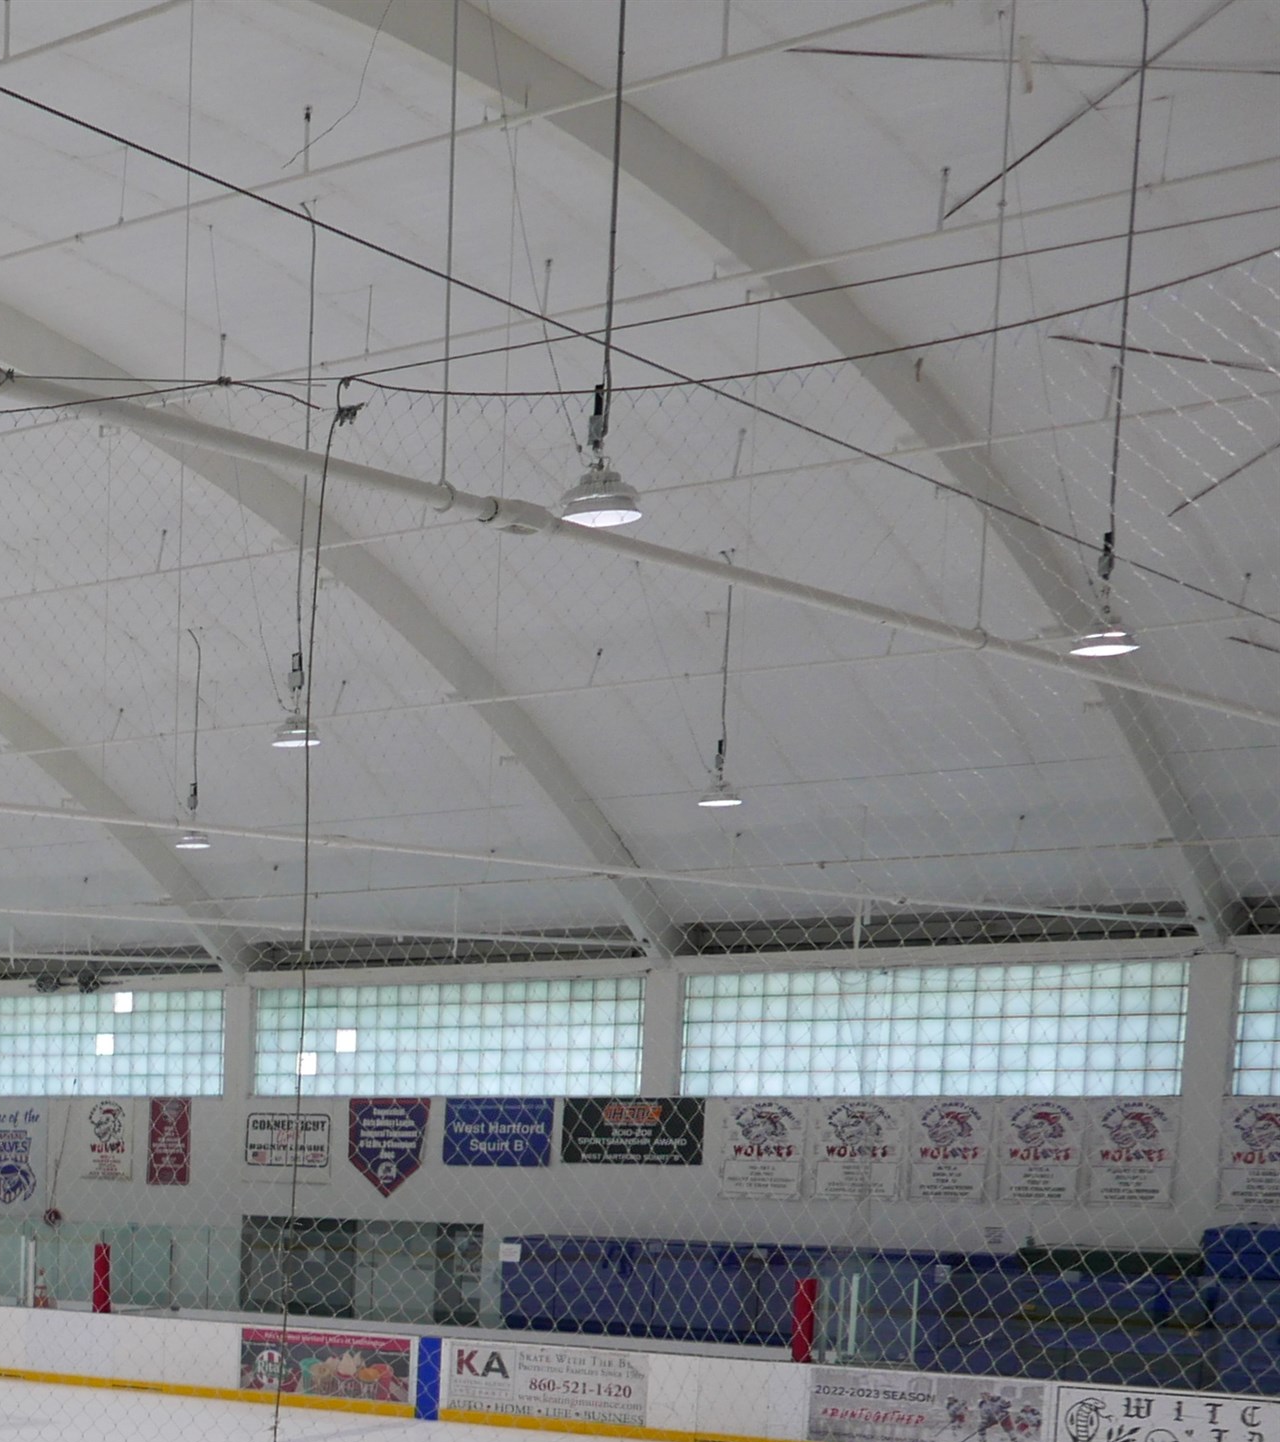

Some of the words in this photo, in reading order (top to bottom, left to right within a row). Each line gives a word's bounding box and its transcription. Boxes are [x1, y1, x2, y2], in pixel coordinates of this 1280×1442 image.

[453, 1122, 486, 1134] West
[489, 1121, 545, 1134] Hartford
[470, 1139, 510, 1153] Squirt
[457, 1349, 510, 1379] KA
[529, 1378, 632, 1399] 860-521-1420
[815, 1385, 880, 1399] 2022-2023
[883, 1390, 936, 1403] SEASON
